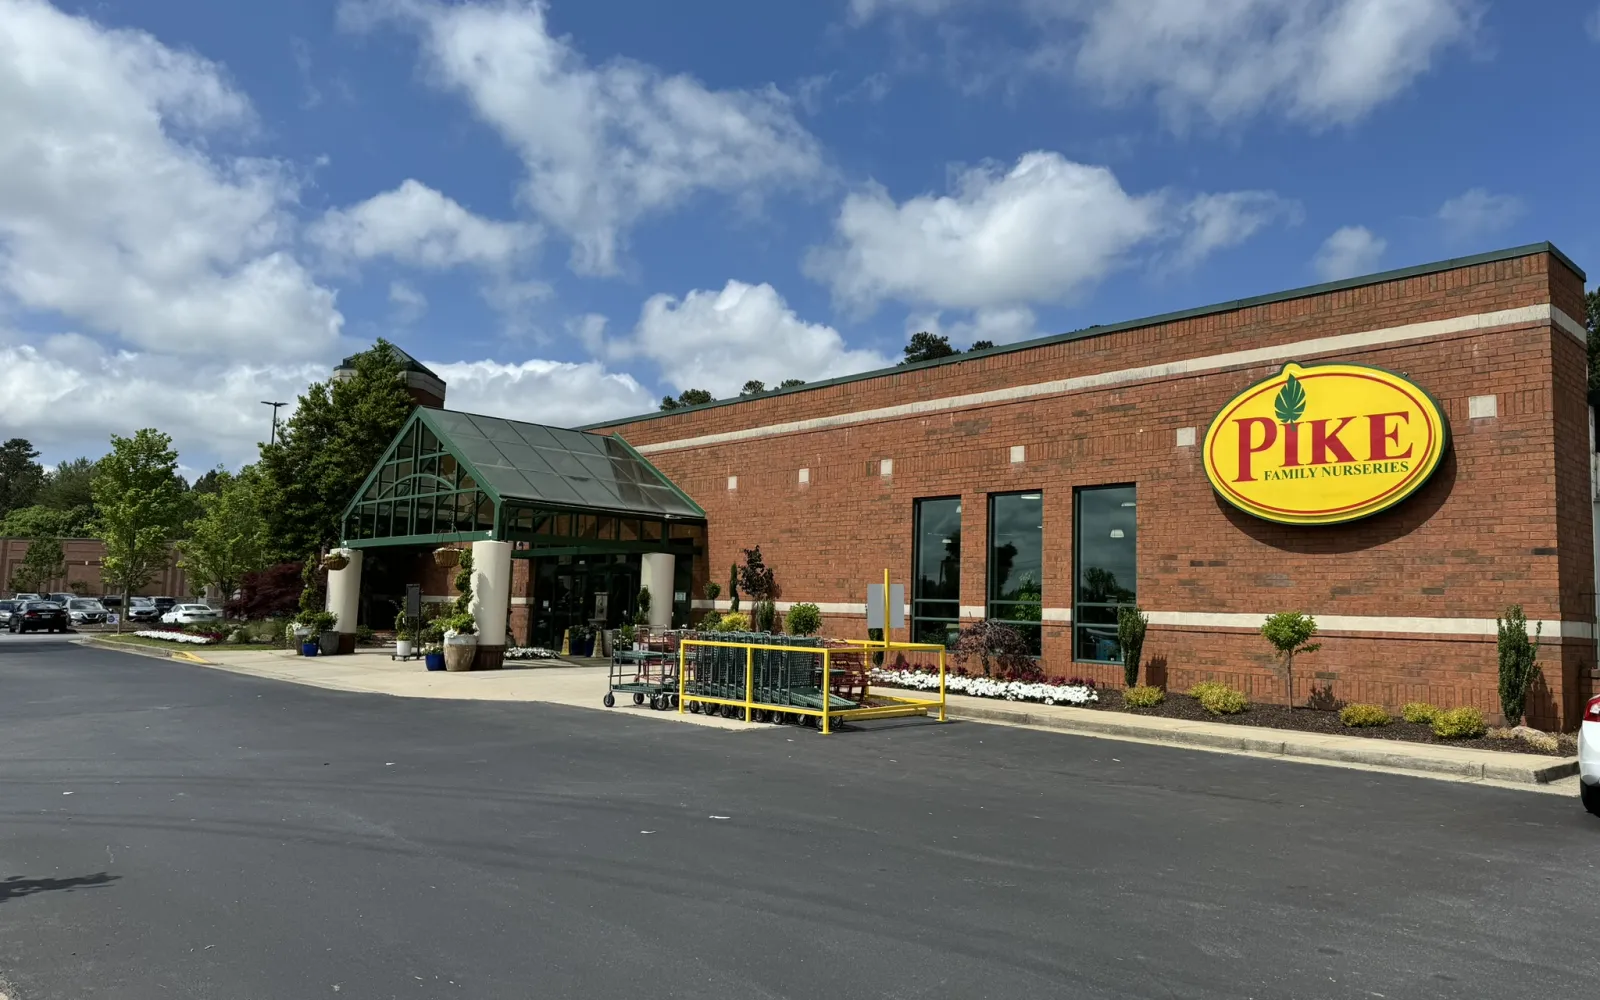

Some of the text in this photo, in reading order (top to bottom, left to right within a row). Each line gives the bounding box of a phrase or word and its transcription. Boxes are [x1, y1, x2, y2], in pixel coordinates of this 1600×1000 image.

[1231, 412, 1413, 482] PIKE
[1264, 461, 1409, 480] FAMILY NURSERIES
